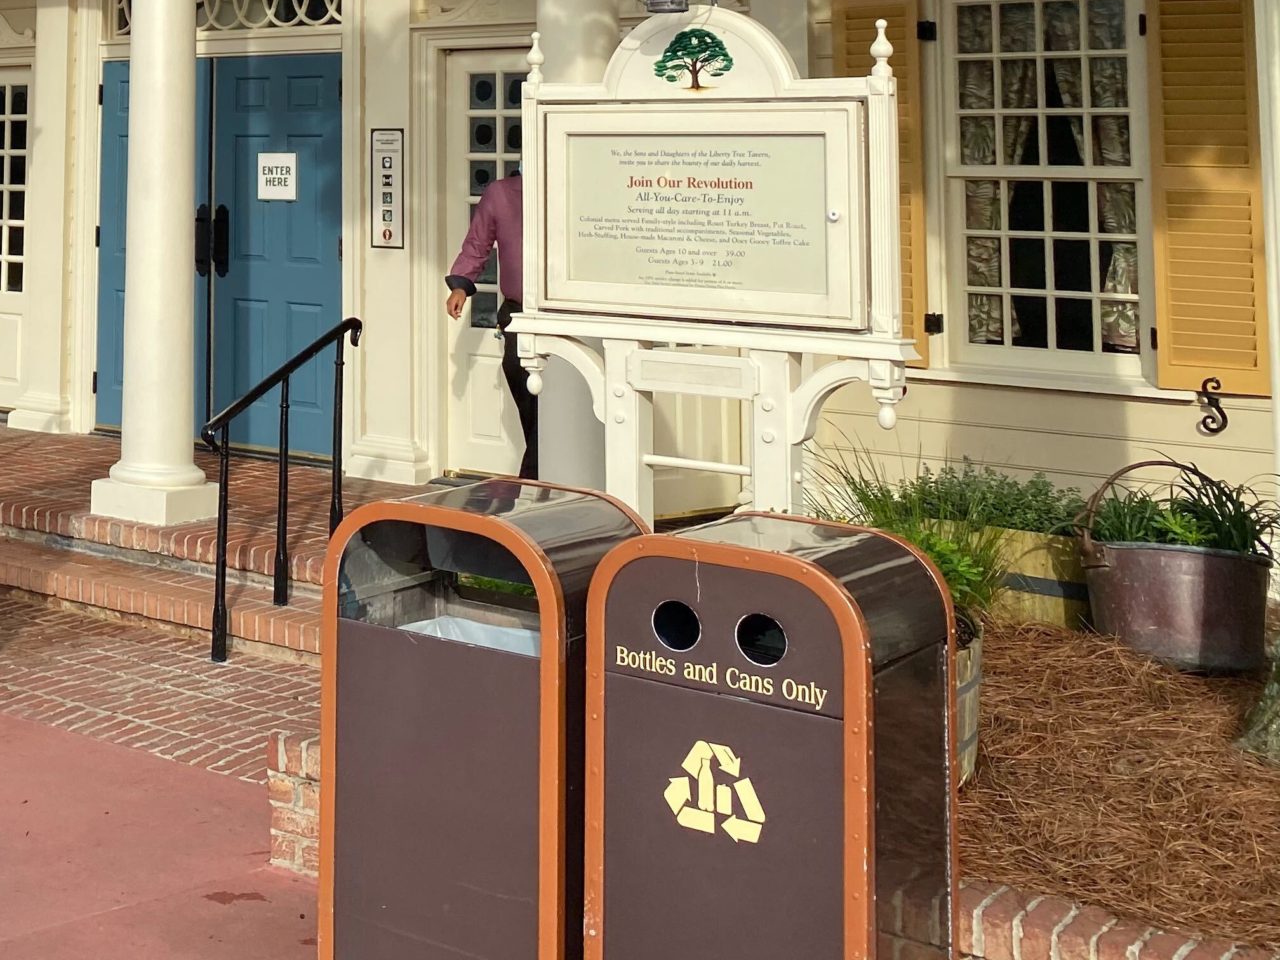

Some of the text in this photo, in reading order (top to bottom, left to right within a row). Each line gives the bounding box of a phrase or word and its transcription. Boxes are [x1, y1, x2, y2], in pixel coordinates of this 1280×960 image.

[660, 150, 689, 158] Daughters
[691, 150, 697, 158] of
[709, 150, 730, 158] Liberty
[732, 150, 745, 158] Tree
[262, 166, 291, 176] ENTER
[265, 177, 289, 187] HERE
[627, 176, 753, 189] Join Our Revolution
[635, 192, 745, 206] All-You-Care-To-Enjoy
[627, 206, 654, 215] Serving
[655, 206, 665, 214] all
[667, 207, 680, 216] day
[682, 208, 710, 216] starting
[635, 246, 658, 254] Guests
[660, 247, 676, 256] Ages
[688, 248, 700, 256] and
[725, 250, 746, 258] 39.00
[647, 256, 670, 265] Guests
[672, 257, 689, 267] Ages
[712, 259, 733, 268] 21.00
[615, 645, 828, 710] Bottles and Cans Only
